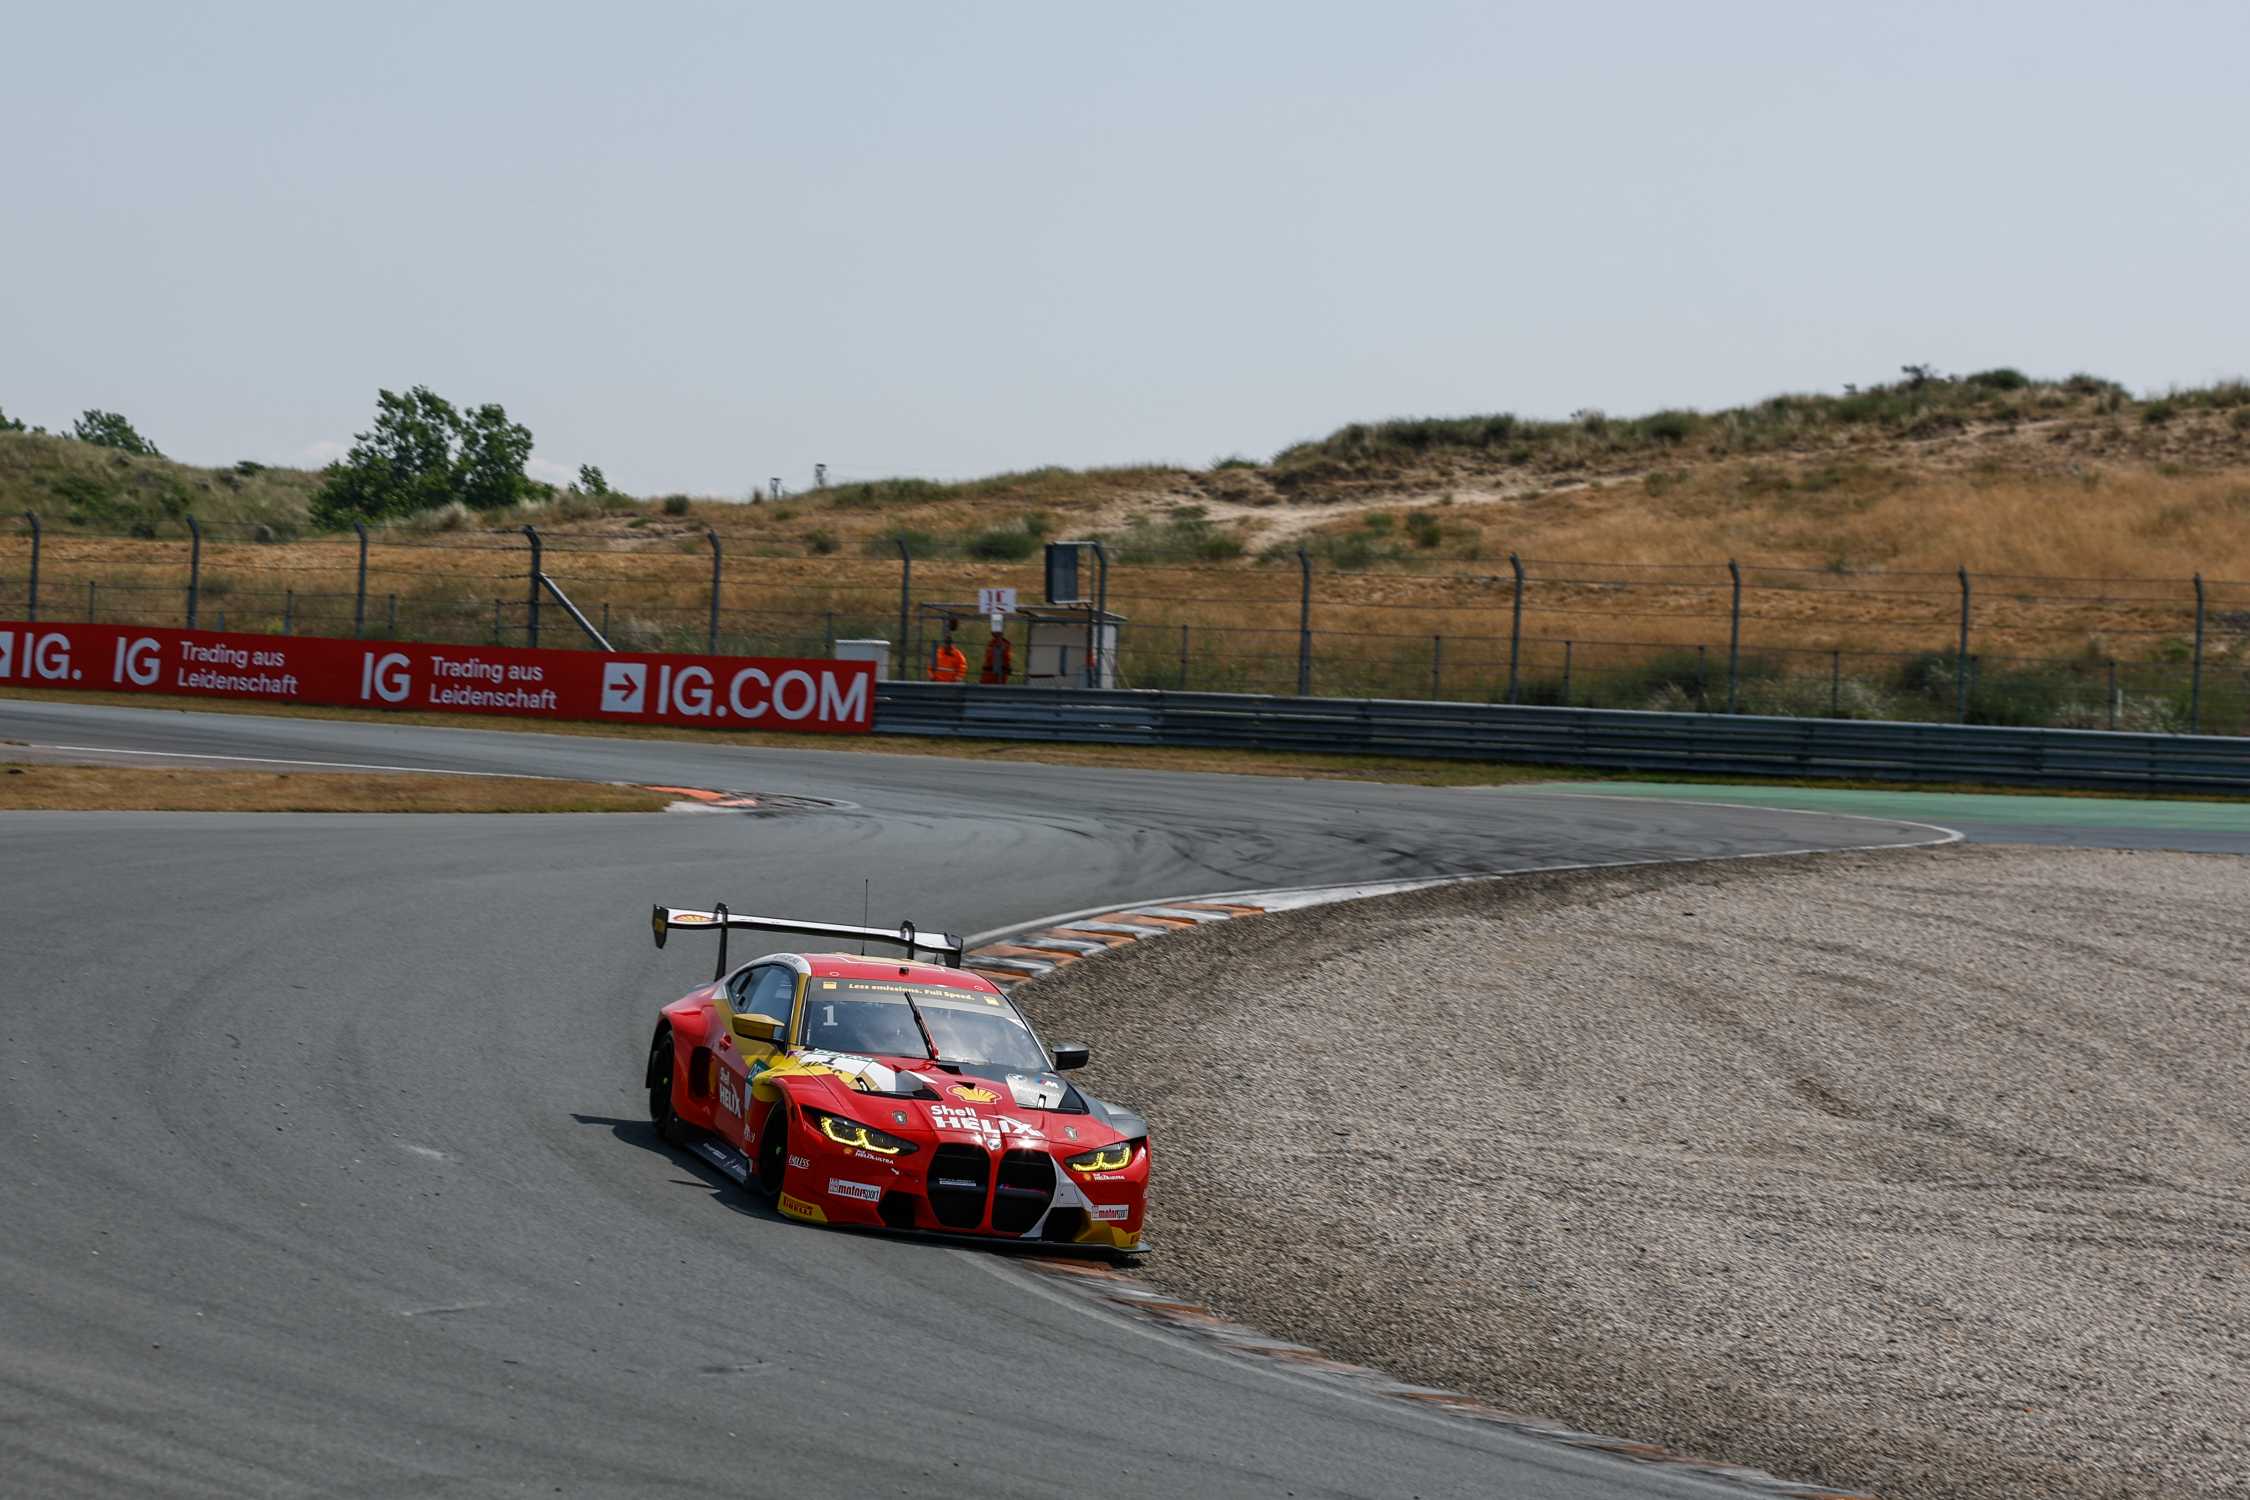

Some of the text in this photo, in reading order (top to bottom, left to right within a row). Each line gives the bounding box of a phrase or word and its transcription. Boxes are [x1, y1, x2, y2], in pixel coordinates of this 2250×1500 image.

[21, 632, 82, 680] IG.
[113, 636, 161, 686] IG
[180, 640, 285, 669] Trading aus
[178, 668, 298, 695] Leidenschaft
[360, 652, 411, 702] IG
[431, 656, 543, 683] Trading aus
[429, 684, 557, 709] Leidenschaft
[656, 665, 868, 722] IG.COM
[924, 988, 943, 996] Full
[944, 991, 975, 1001] Speed.
[823, 1005, 838, 1027] 1
[720, 1083, 742, 1118] HELIX
[931, 1105, 976, 1117] Shell
[933, 1114, 1045, 1138] HELIX
